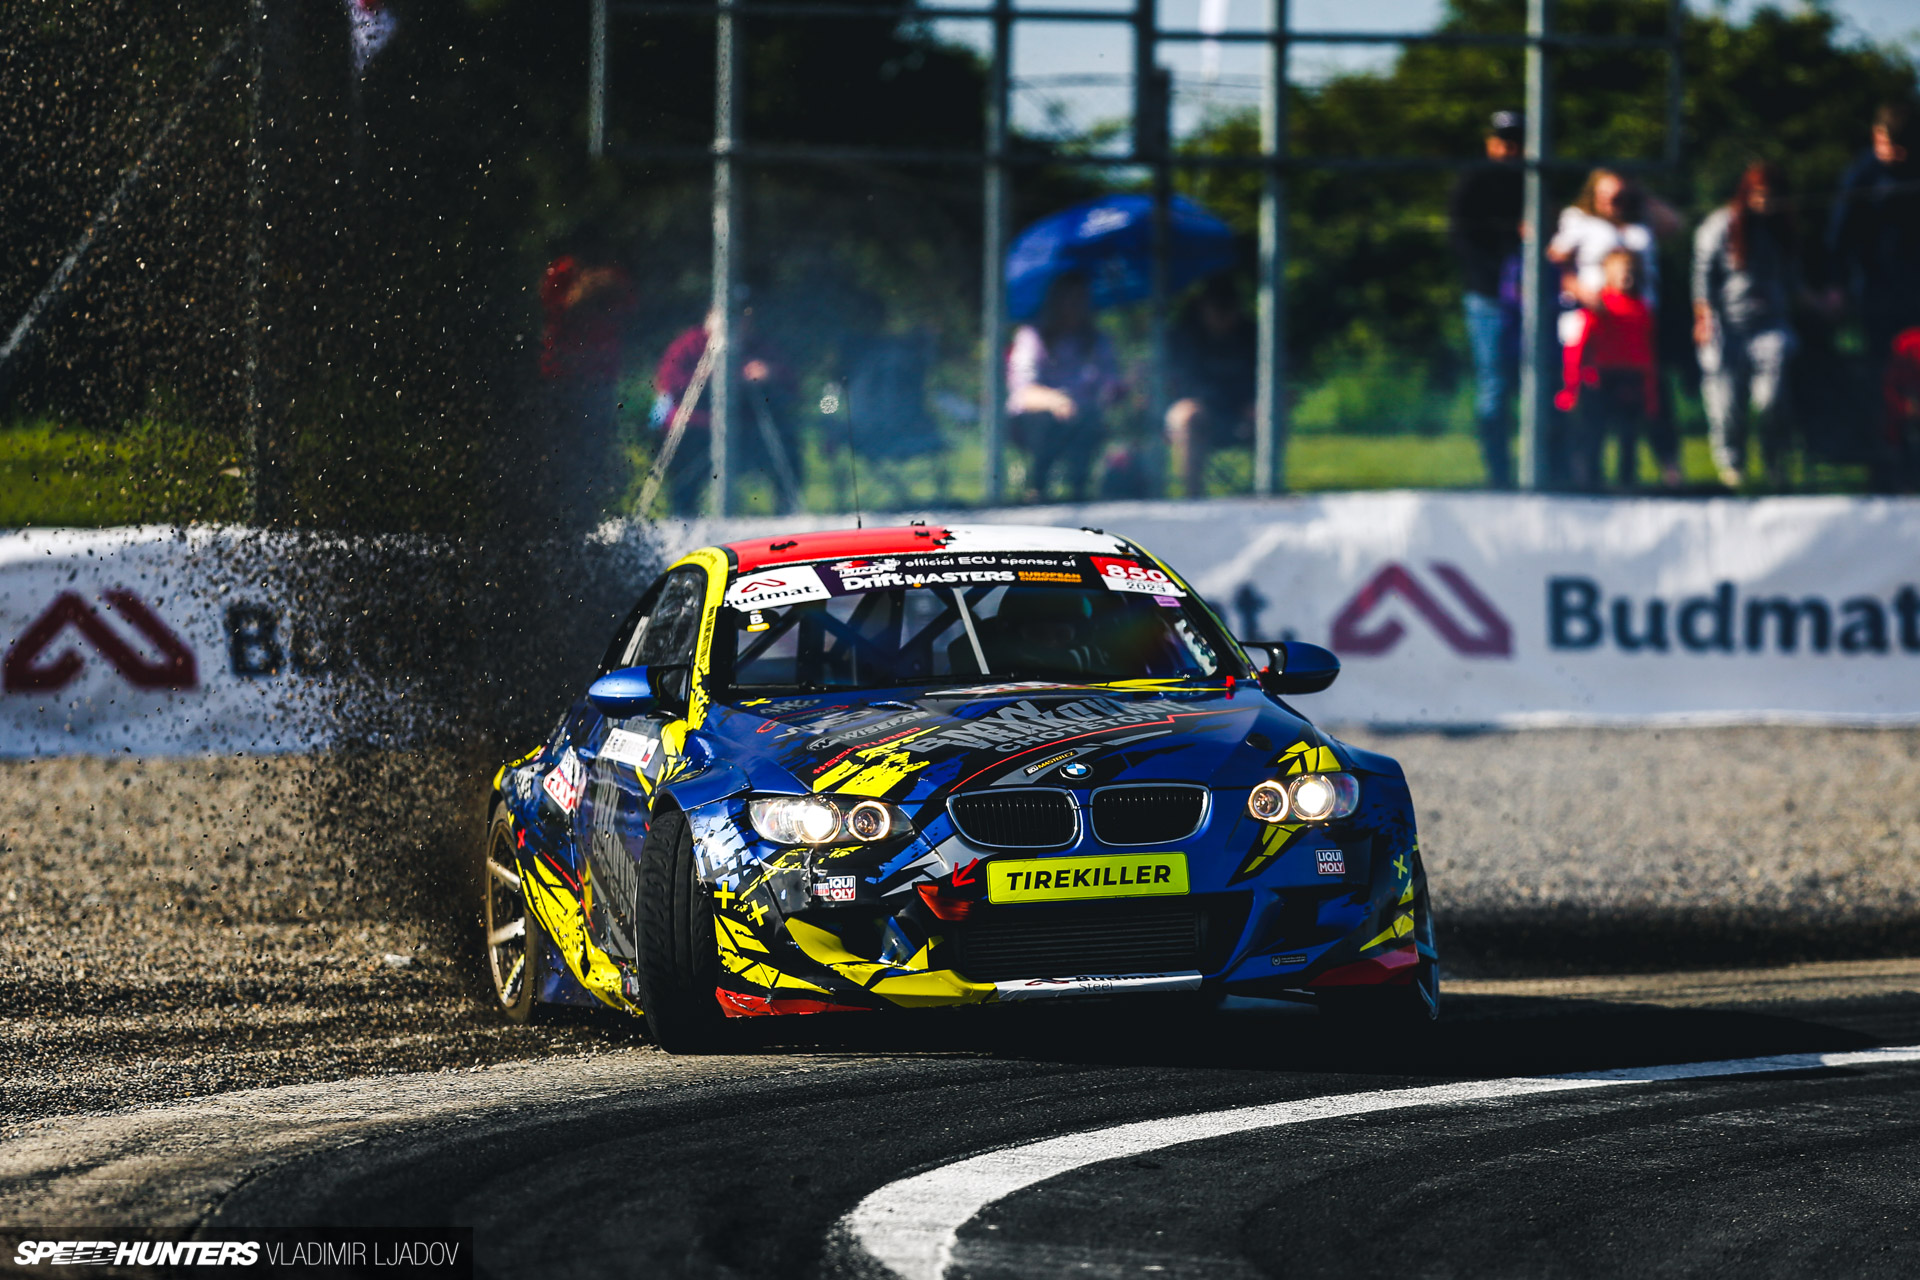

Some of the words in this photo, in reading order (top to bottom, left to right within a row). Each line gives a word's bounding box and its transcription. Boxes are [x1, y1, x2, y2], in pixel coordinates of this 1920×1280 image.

[958, 556, 996, 565] ECU
[1001, 557, 1058, 566] sponsor
[906, 571, 1016, 585] MASTERS
[1106, 564, 1169, 583] 850
[1318, 852, 1342, 862] LIQUI
[1320, 862, 1344, 872] MOLY
[1006, 864, 1172, 891] TIREKILLER
[829, 878, 854, 889] IQUI
[1079, 982, 1113, 993] Steel
